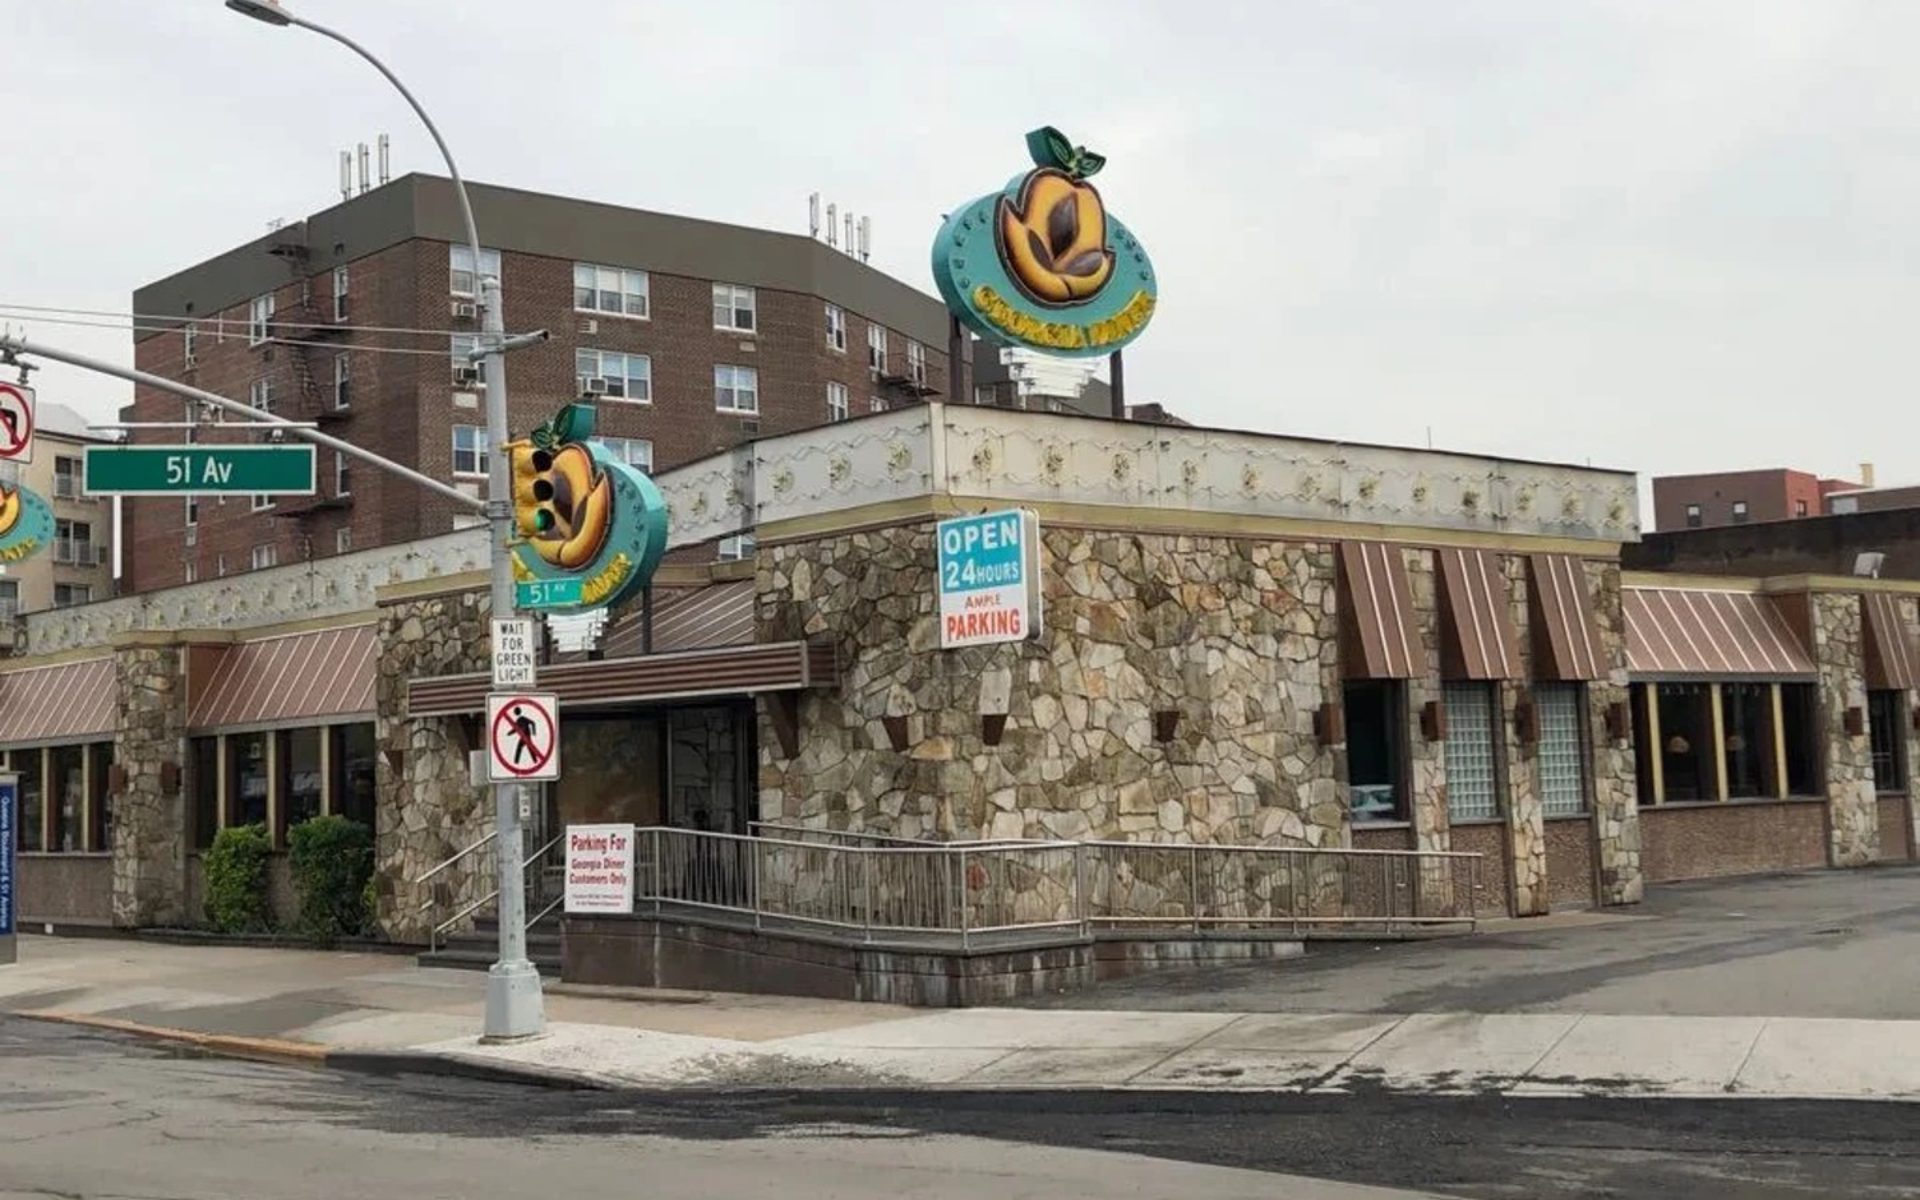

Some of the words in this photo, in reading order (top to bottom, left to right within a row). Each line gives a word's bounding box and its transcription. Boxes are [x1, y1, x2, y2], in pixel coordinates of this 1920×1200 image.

[167, 456, 191, 483] 51
[202, 456, 232, 483] Av
[943, 519, 1018, 555] OPEN
[530, 584, 551, 604] 51
[964, 593, 1003, 609] AMPLE
[501, 623, 525, 635] WAIT
[946, 608, 1021, 642] PARKING
[502, 637, 525, 650] FOR
[496, 652, 532, 666] GREEN
[499, 668, 529, 682] LIGHT
[571, 834, 608, 855] Parking
[610, 833, 626, 850] For
[571, 858, 602, 871] Georgia
[604, 857, 625, 869] Diner
[569, 873, 608, 884] Customers
[610, 872, 627, 886] Only
